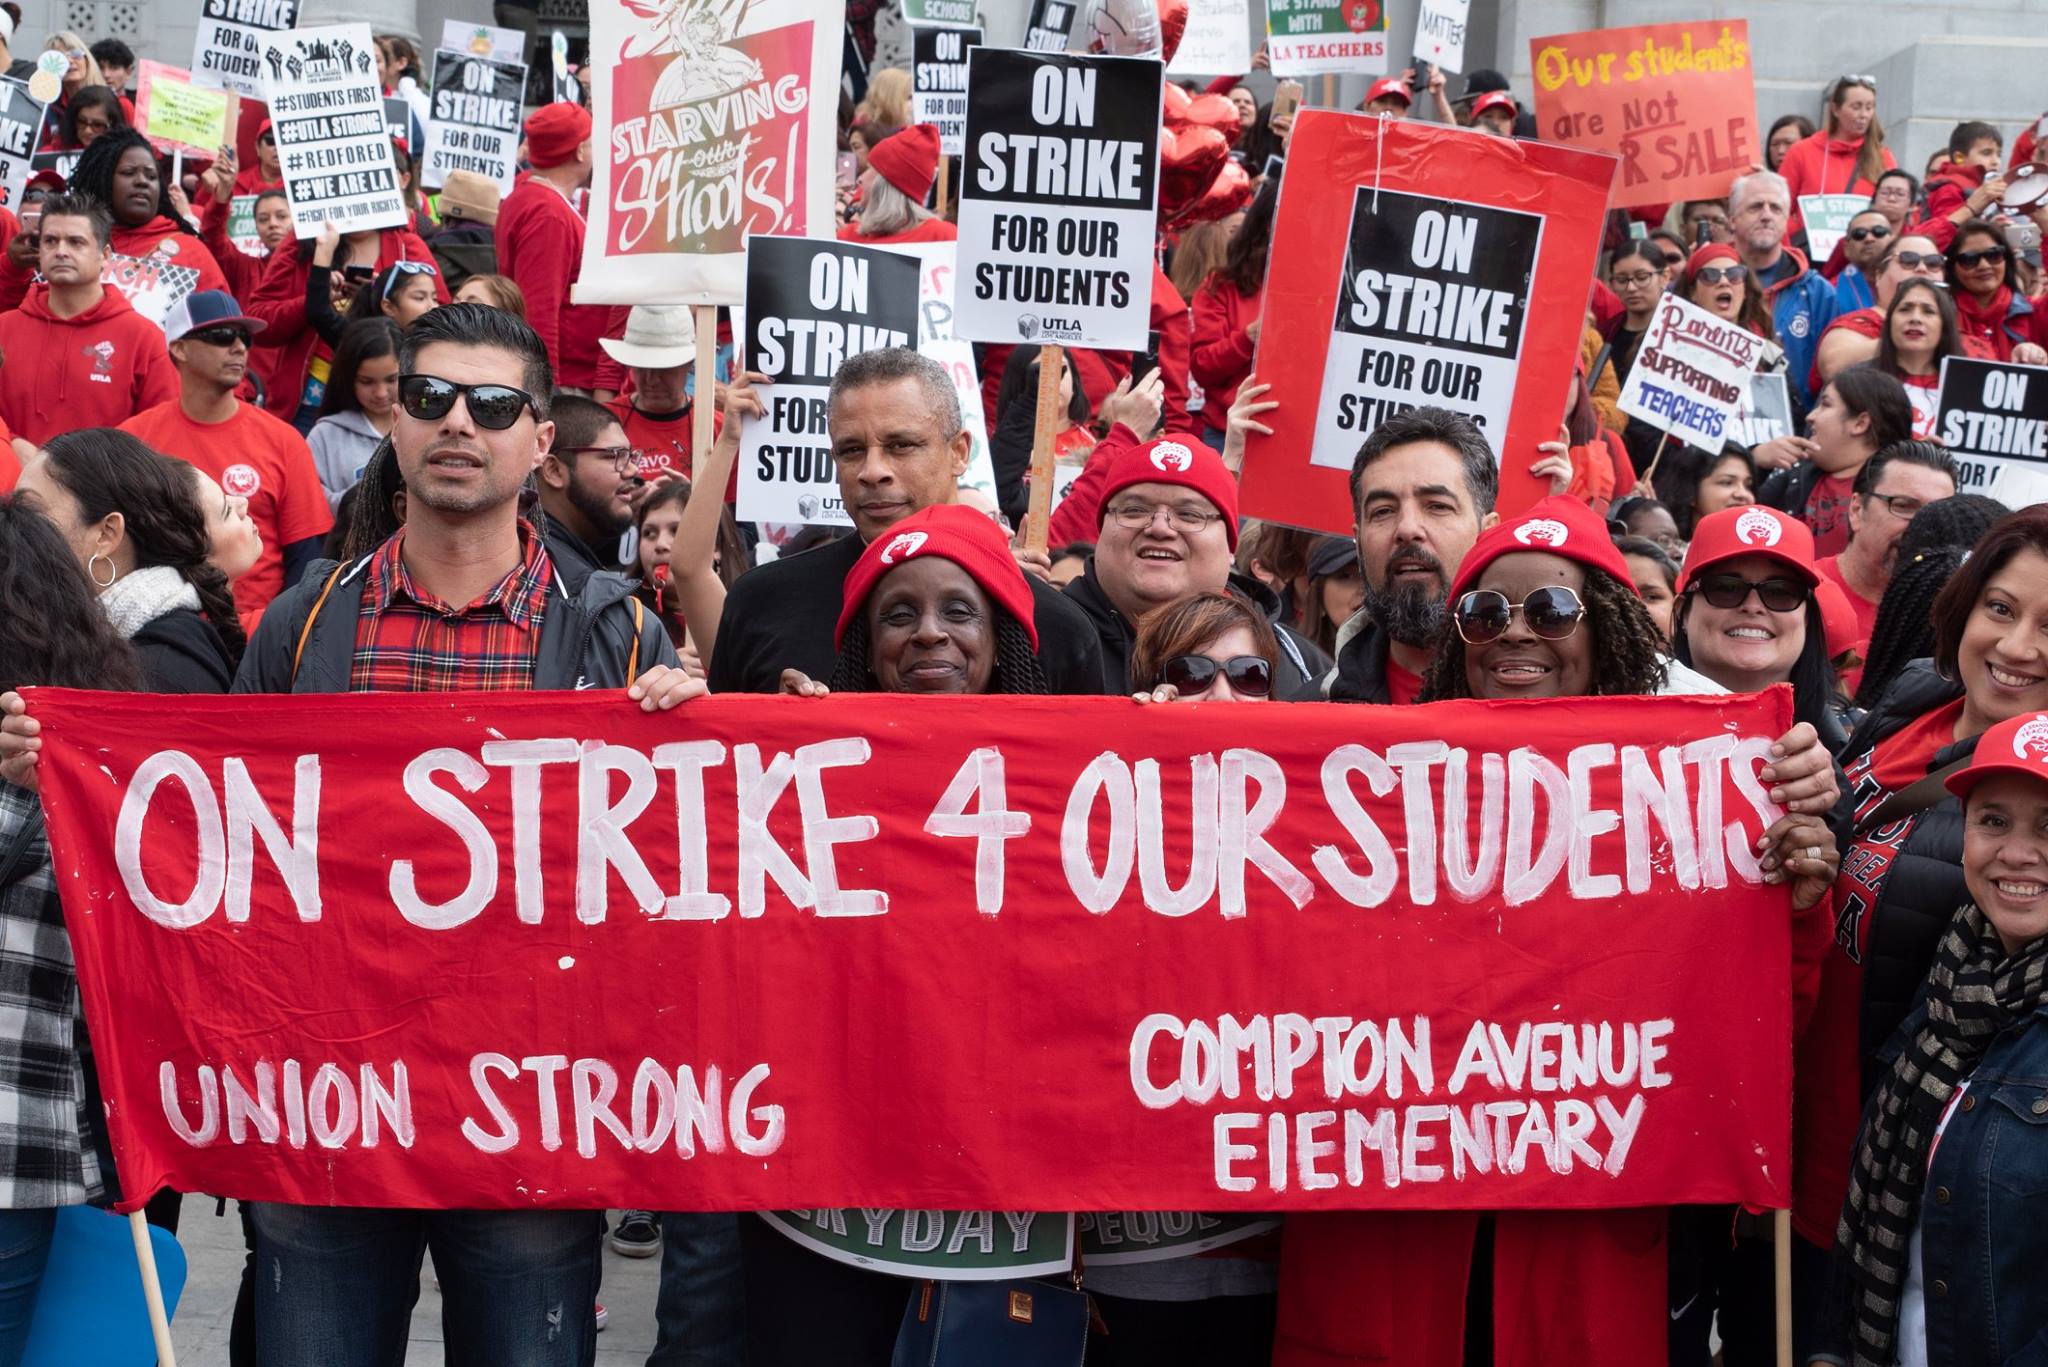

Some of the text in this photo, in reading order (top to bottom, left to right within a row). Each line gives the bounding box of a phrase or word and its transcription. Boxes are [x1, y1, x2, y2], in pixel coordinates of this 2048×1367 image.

[1045, 4, 1067, 30] ON
[1288, 14, 1323, 33] WITH
[214, 27, 241, 49] FOR
[935, 32, 961, 60] ON
[1297, 42, 1385, 60] TEACHERS
[203, 49, 261, 78] STUDEN
[917, 62, 967, 91] STRIK
[1535, 26, 1747, 91] Our students
[463, 61, 495, 94] ON
[275, 86, 377, 113] #STUDENTS FIRST
[435, 89, 515, 131] STRIKE
[925, 98, 944, 115] FOR
[1031, 64, 1096, 128] ON
[281, 117, 329, 143] #UTLA
[331, 111, 380, 135] STRONG
[612, 74, 808, 164] STARVING
[1553, 111, 1605, 141] are
[287, 143, 387, 171] #REDFORED
[442, 129, 501, 155] FOR OUR
[1655, 116, 1751, 181] SALE
[433, 150, 505, 179] STUDENTS
[977, 131, 1143, 200] STRIKE
[295, 170, 390, 201] #WE ARE LA
[298, 198, 400, 223] #FIGHT FOR YOUR RIGHTS
[992, 213, 1119, 258] FOR OUR
[1411, 210, 1478, 275] ON
[809, 252, 869, 314] ON
[975, 262, 1130, 309] STUDENTS
[1042, 317, 1082, 332] UTLA
[1350, 268, 1515, 349] STRIKE
[1358, 347, 1482, 402] FOR OUR
[1640, 346, 1740, 404] SUPPORTING
[1982, 370, 2016, 411] ON
[772, 396, 827, 436] FOR
[1943, 409, 2048, 458] STRIKE
[757, 445, 841, 484] STUD
[1956, 461, 1985, 486] OR
[823, 498, 846, 510] UT
[115, 749, 323, 929] ON
[388, 736, 890, 930] STRIKE
[924, 747, 1032, 917] 4
[1060, 749, 1314, 918] OUR
[1311, 733, 1784, 908] STUDENTS
[1129, 1012, 1674, 1109] COMPTON AVENUE
[159, 1051, 786, 1159] UNION STRONG
